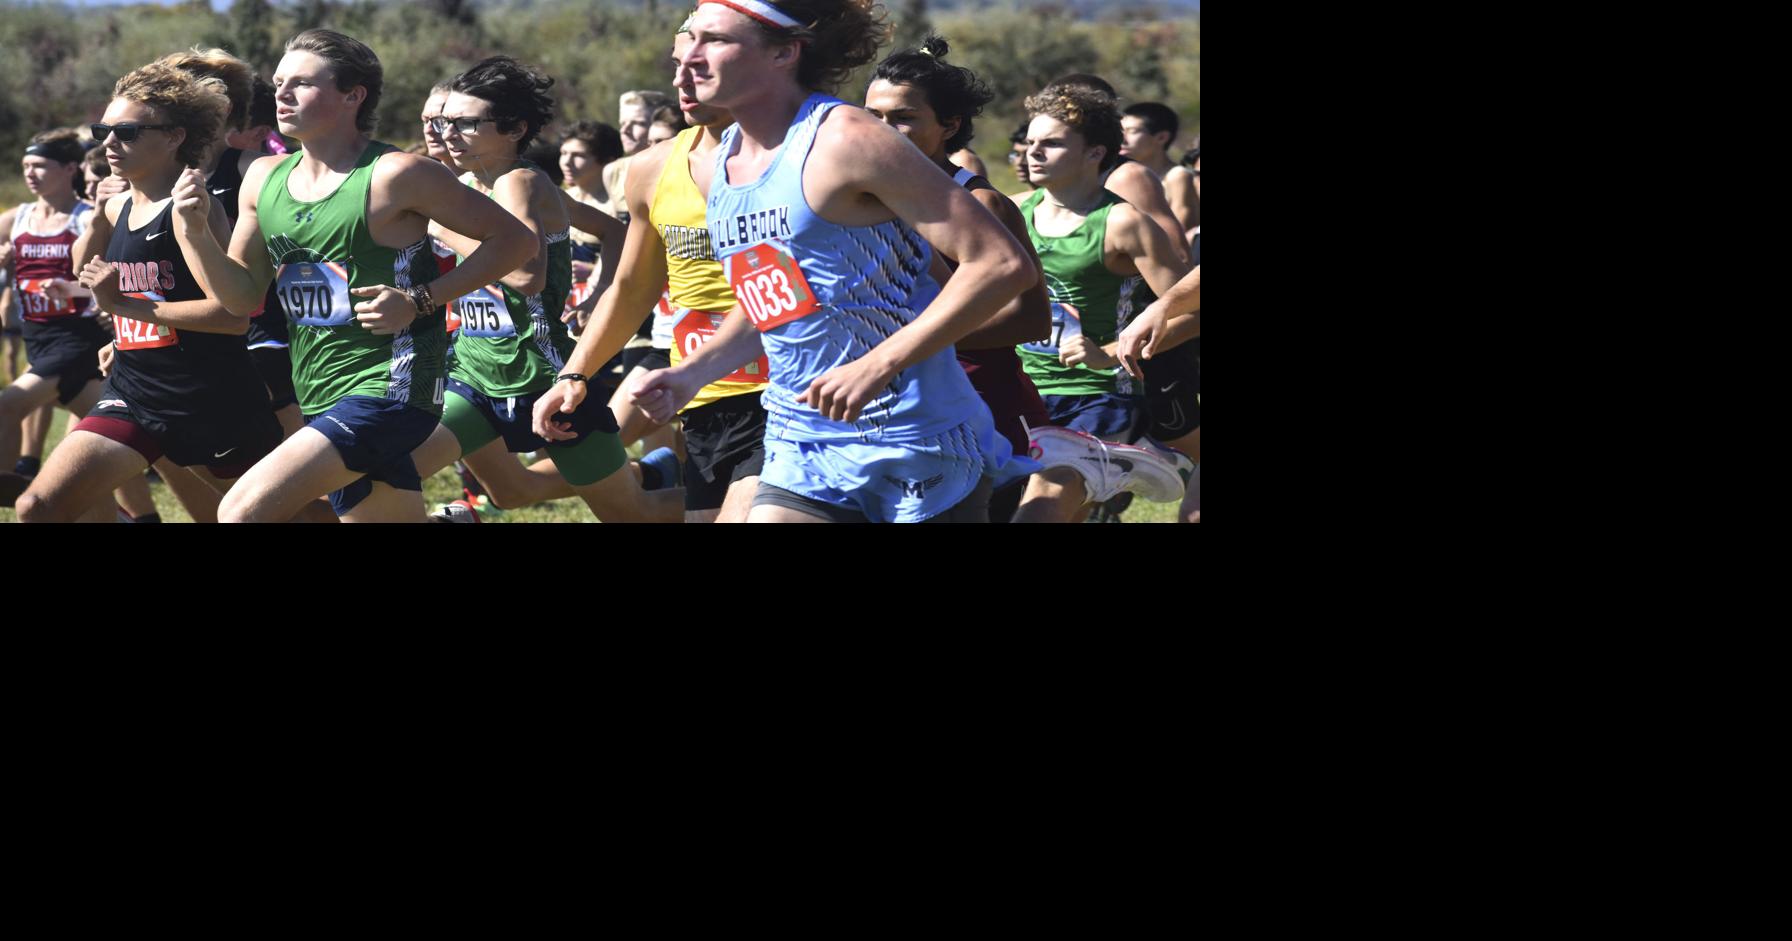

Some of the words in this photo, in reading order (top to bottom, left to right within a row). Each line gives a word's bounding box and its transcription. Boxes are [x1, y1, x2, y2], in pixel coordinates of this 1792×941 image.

[21, 244, 69, 259] PHOENIX
[279, 285, 332, 319] 1970
[736, 268, 797, 325] 1033
[461, 300, 500, 331] 1975
